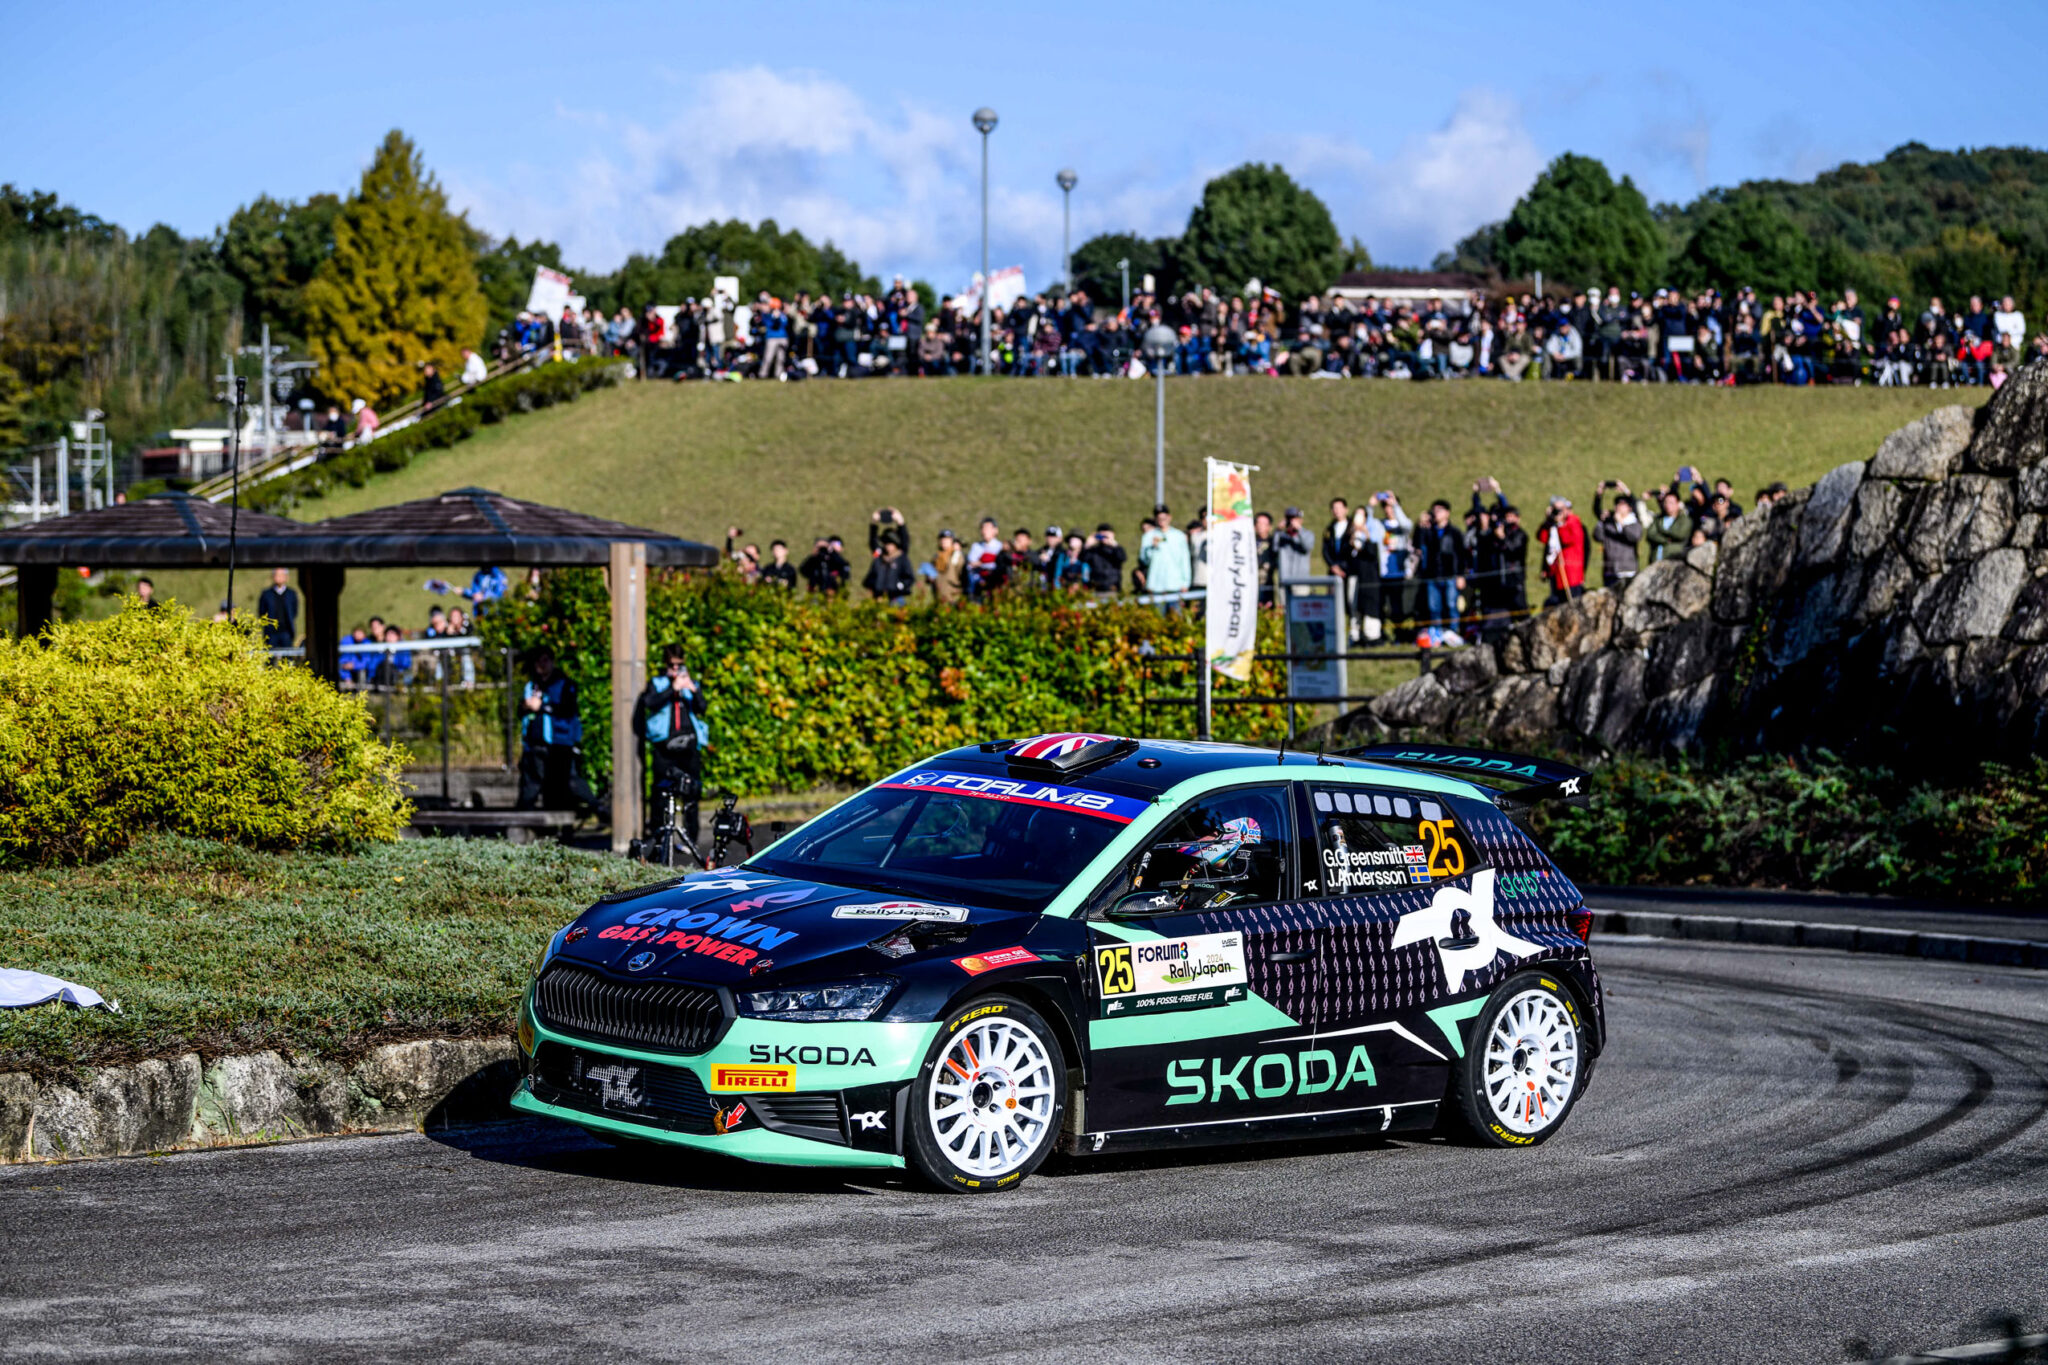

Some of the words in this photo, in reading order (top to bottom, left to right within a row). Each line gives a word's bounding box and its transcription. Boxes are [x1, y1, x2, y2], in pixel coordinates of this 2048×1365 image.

[931, 774, 1114, 810] FORUM8
[1323, 846, 1406, 867] G.Greensmith
[1418, 819, 1465, 877] 25
[1327, 867, 1407, 887] J.Andersson
[1501, 874, 1538, 898] gap
[625, 907, 799, 950] CROWN
[598, 925, 658, 942] GAS
[657, 931, 758, 966] POWER
[1138, 941, 1188, 963] FORUM8
[1169, 959, 1231, 981] RallyJapan
[1206, 954, 1224, 964] 2024
[1100, 947, 1134, 995] 25
[1136, 998, 1155, 1007] 100%
[1156, 993, 1198, 1005] FOSSIL-FREE
[1197, 992, 1214, 1001] FUEL
[718, 1069, 789, 1087] PIRELLI
